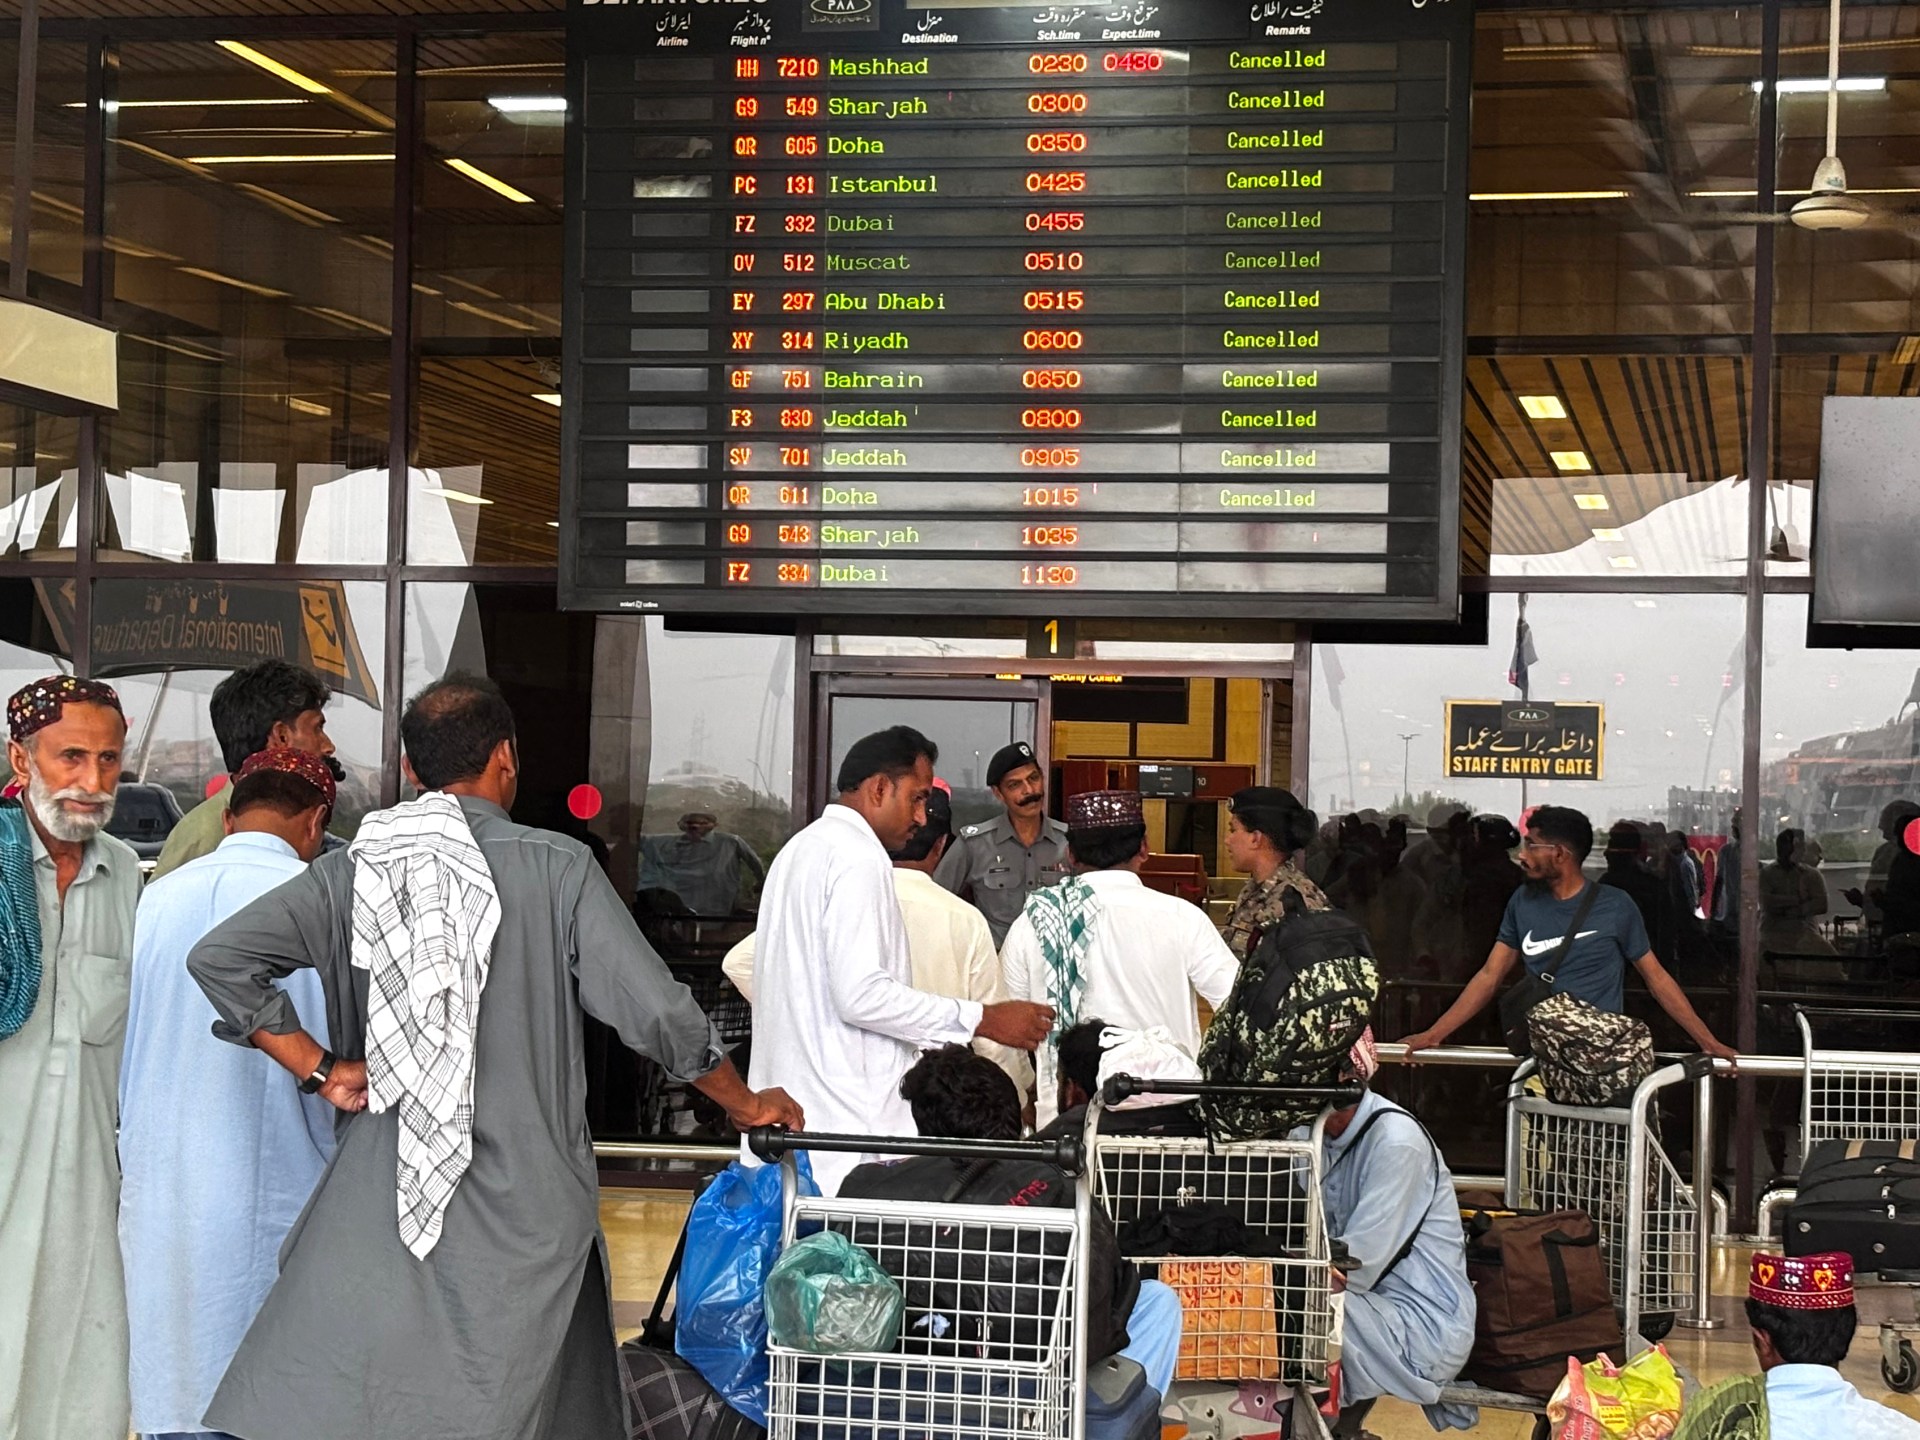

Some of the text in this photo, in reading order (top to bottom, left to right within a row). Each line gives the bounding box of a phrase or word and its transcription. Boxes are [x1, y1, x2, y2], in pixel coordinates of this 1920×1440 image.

[917, 10, 942, 31] منزل
[1033, 7, 1086, 26] مقررہ وقت
[1105, 1, 1159, 25] متوقع وقت
[657, 36, 689, 47] Airline
[730, 35, 758, 48] Flight
[902, 33, 958, 44] Destination
[1265, 26, 1311, 36] Remarks
[736, 50, 1325, 78] HH 7210 Mashhad 0230 0430 Cancelled
[735, 90, 1324, 119] G9 549 Sharjah 0300 Cancelled
[734, 131, 1323, 156] QR 605 Doha 0350 Cancelled
[733, 170, 1322, 194] PC 131 Istanbul 0425 Cancelled
[736, 212, 1322, 234] FZ 332 Dubai 0455 Cancelled
[734, 252, 1321, 272] OV 512 Muscat 0510 Cancelled
[732, 290, 1320, 312] EY 297 Abu Dhabi 0515 Cancelled
[733, 330, 1319, 353] XY 314 Riyadh 0600 Cancelled
[731, 369, 1318, 389] GF 751 Bahrain 0650 Cancelled
[731, 408, 1317, 429] F3 830 Jeddah 0800 Cancelled
[730, 447, 1316, 467] SV 701 Jeddah 0905 Cancelled
[728, 485, 1316, 507] QR 611 Doha 1015 Cancelled
[727, 524, 1078, 547] G9 543 Sharjah 1035
[727, 561, 1077, 586] FZ 334 Dubai 1130
[1044, 620, 1058, 654] 1
[1519, 711, 1538, 719] PAA
[1454, 727, 1490, 753] عملہ
[1548, 728, 1594, 754] داخلہ
[1453, 756, 1593, 775] STAFF ENTRY GATE
[1197, 777, 1207, 786] 10
